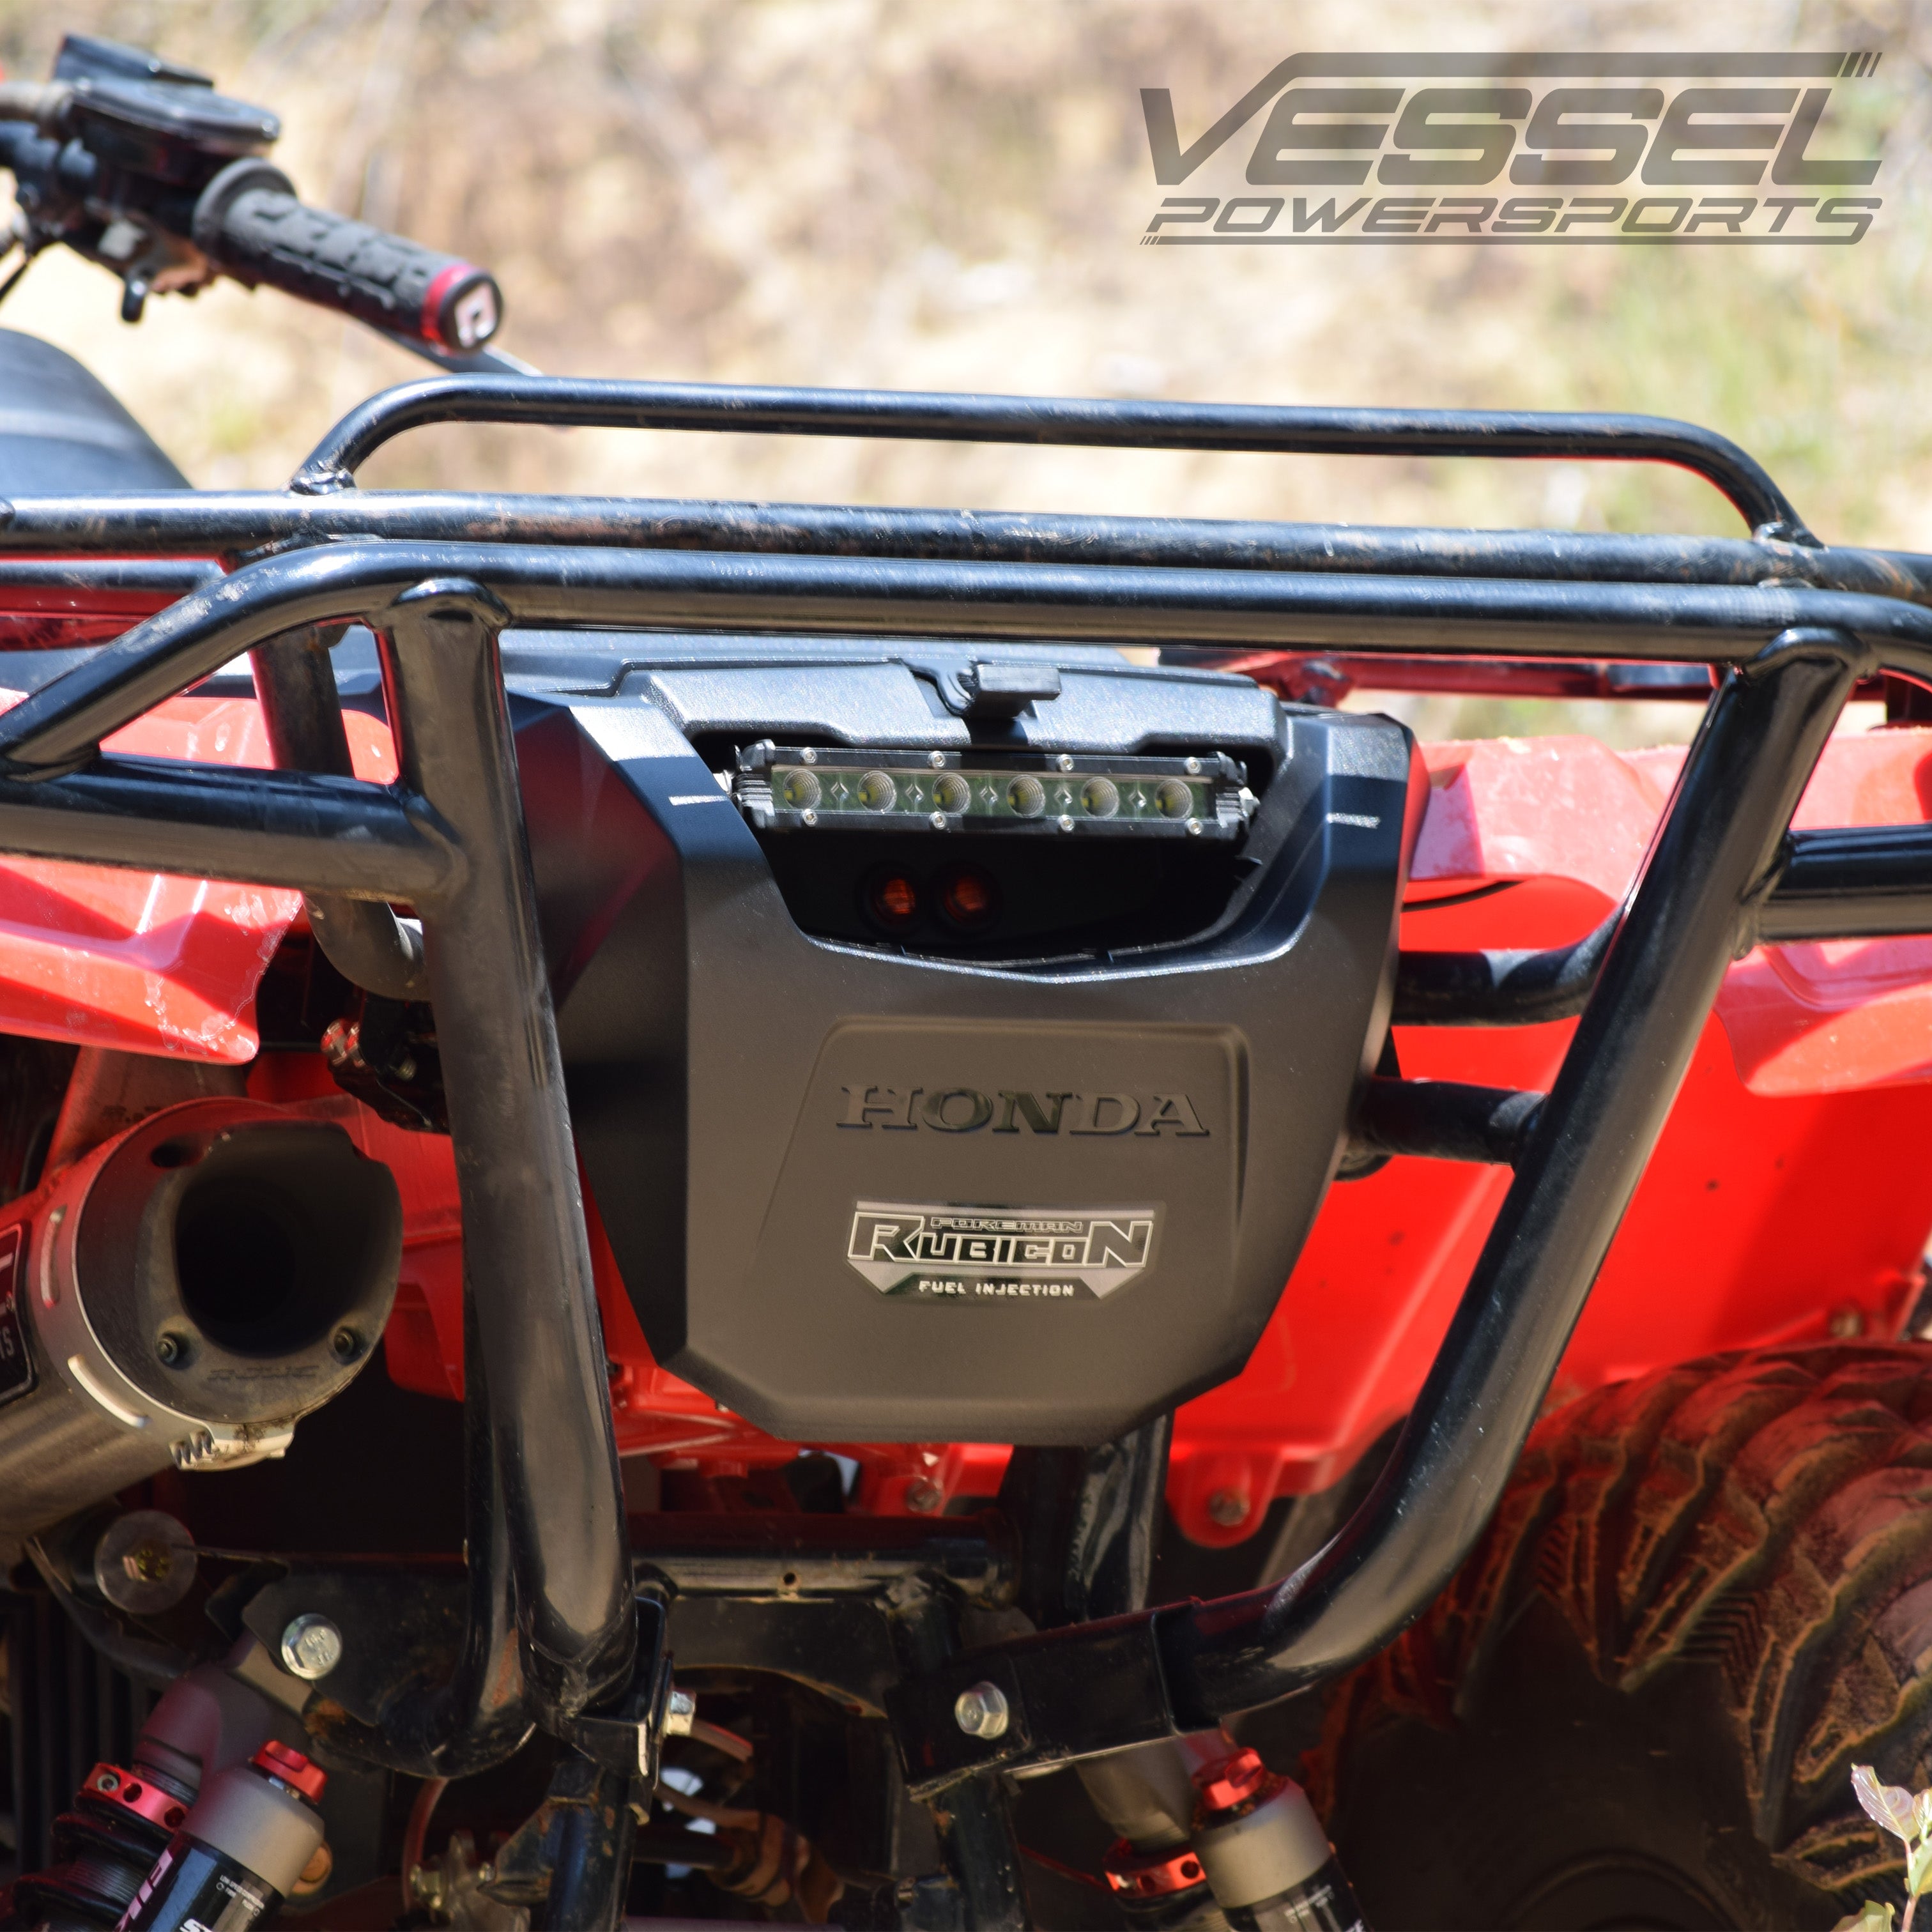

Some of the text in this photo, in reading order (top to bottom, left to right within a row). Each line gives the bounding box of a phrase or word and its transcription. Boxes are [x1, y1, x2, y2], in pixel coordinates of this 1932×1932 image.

[836, 1085, 1211, 1137] HONDA
[847, 1211, 1154, 1268] RUBICON
[930, 1216, 1084, 1234] FOREMAN
[918, 1280, 1075, 1297] FUEL INJECTION
